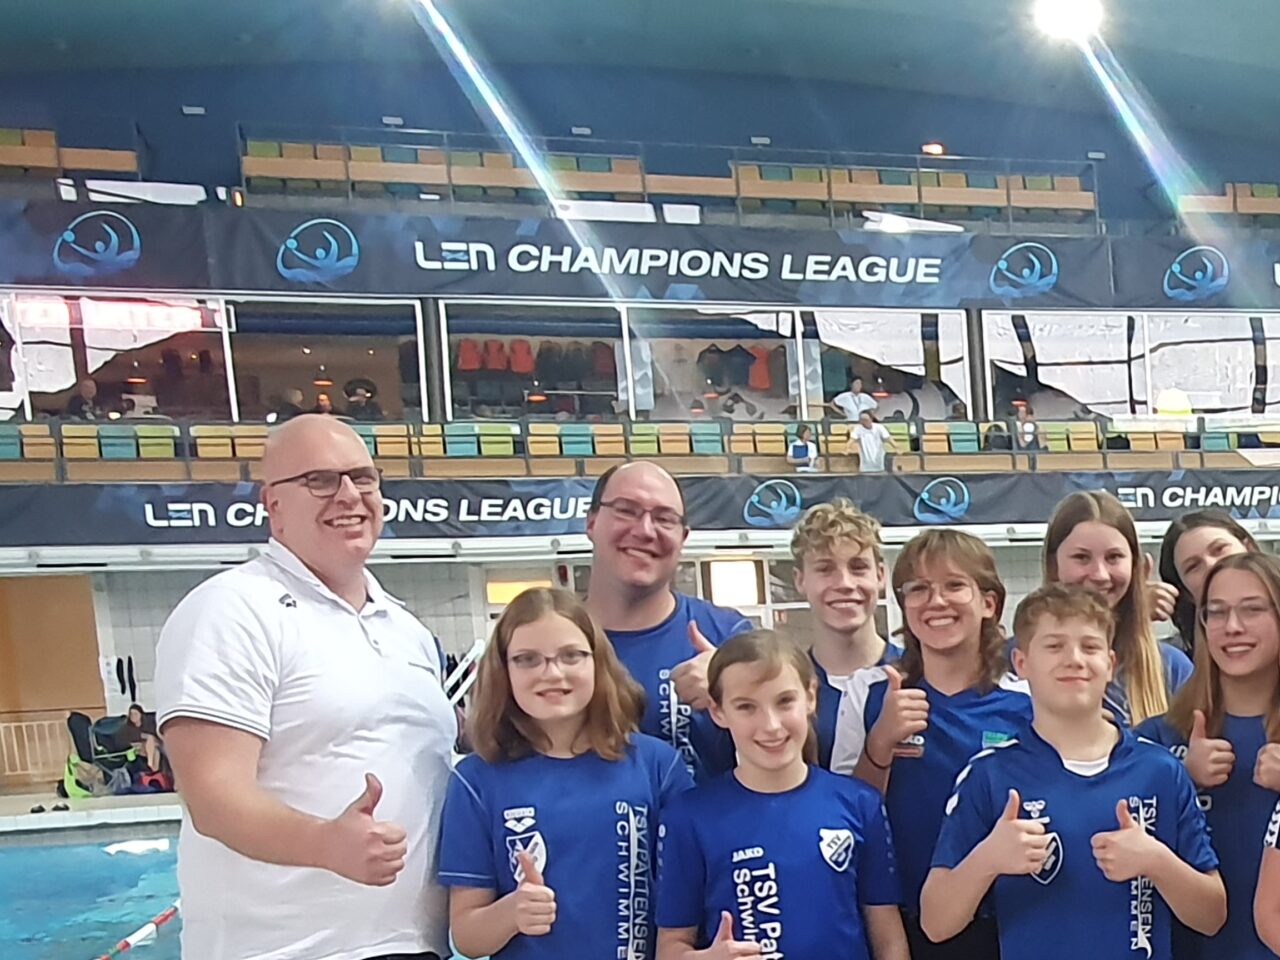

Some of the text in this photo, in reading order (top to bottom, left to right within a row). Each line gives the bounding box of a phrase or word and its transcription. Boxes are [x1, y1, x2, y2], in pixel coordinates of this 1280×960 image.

[508, 243, 769, 279] CHAMPIONS
[781, 253, 942, 283] LEAGUE
[1102, 486, 1155, 508] EN
[633, 804, 648, 848] TSV
[752, 863, 781, 914] TSV
[1141, 796, 1156, 938] TSV ENSEN
